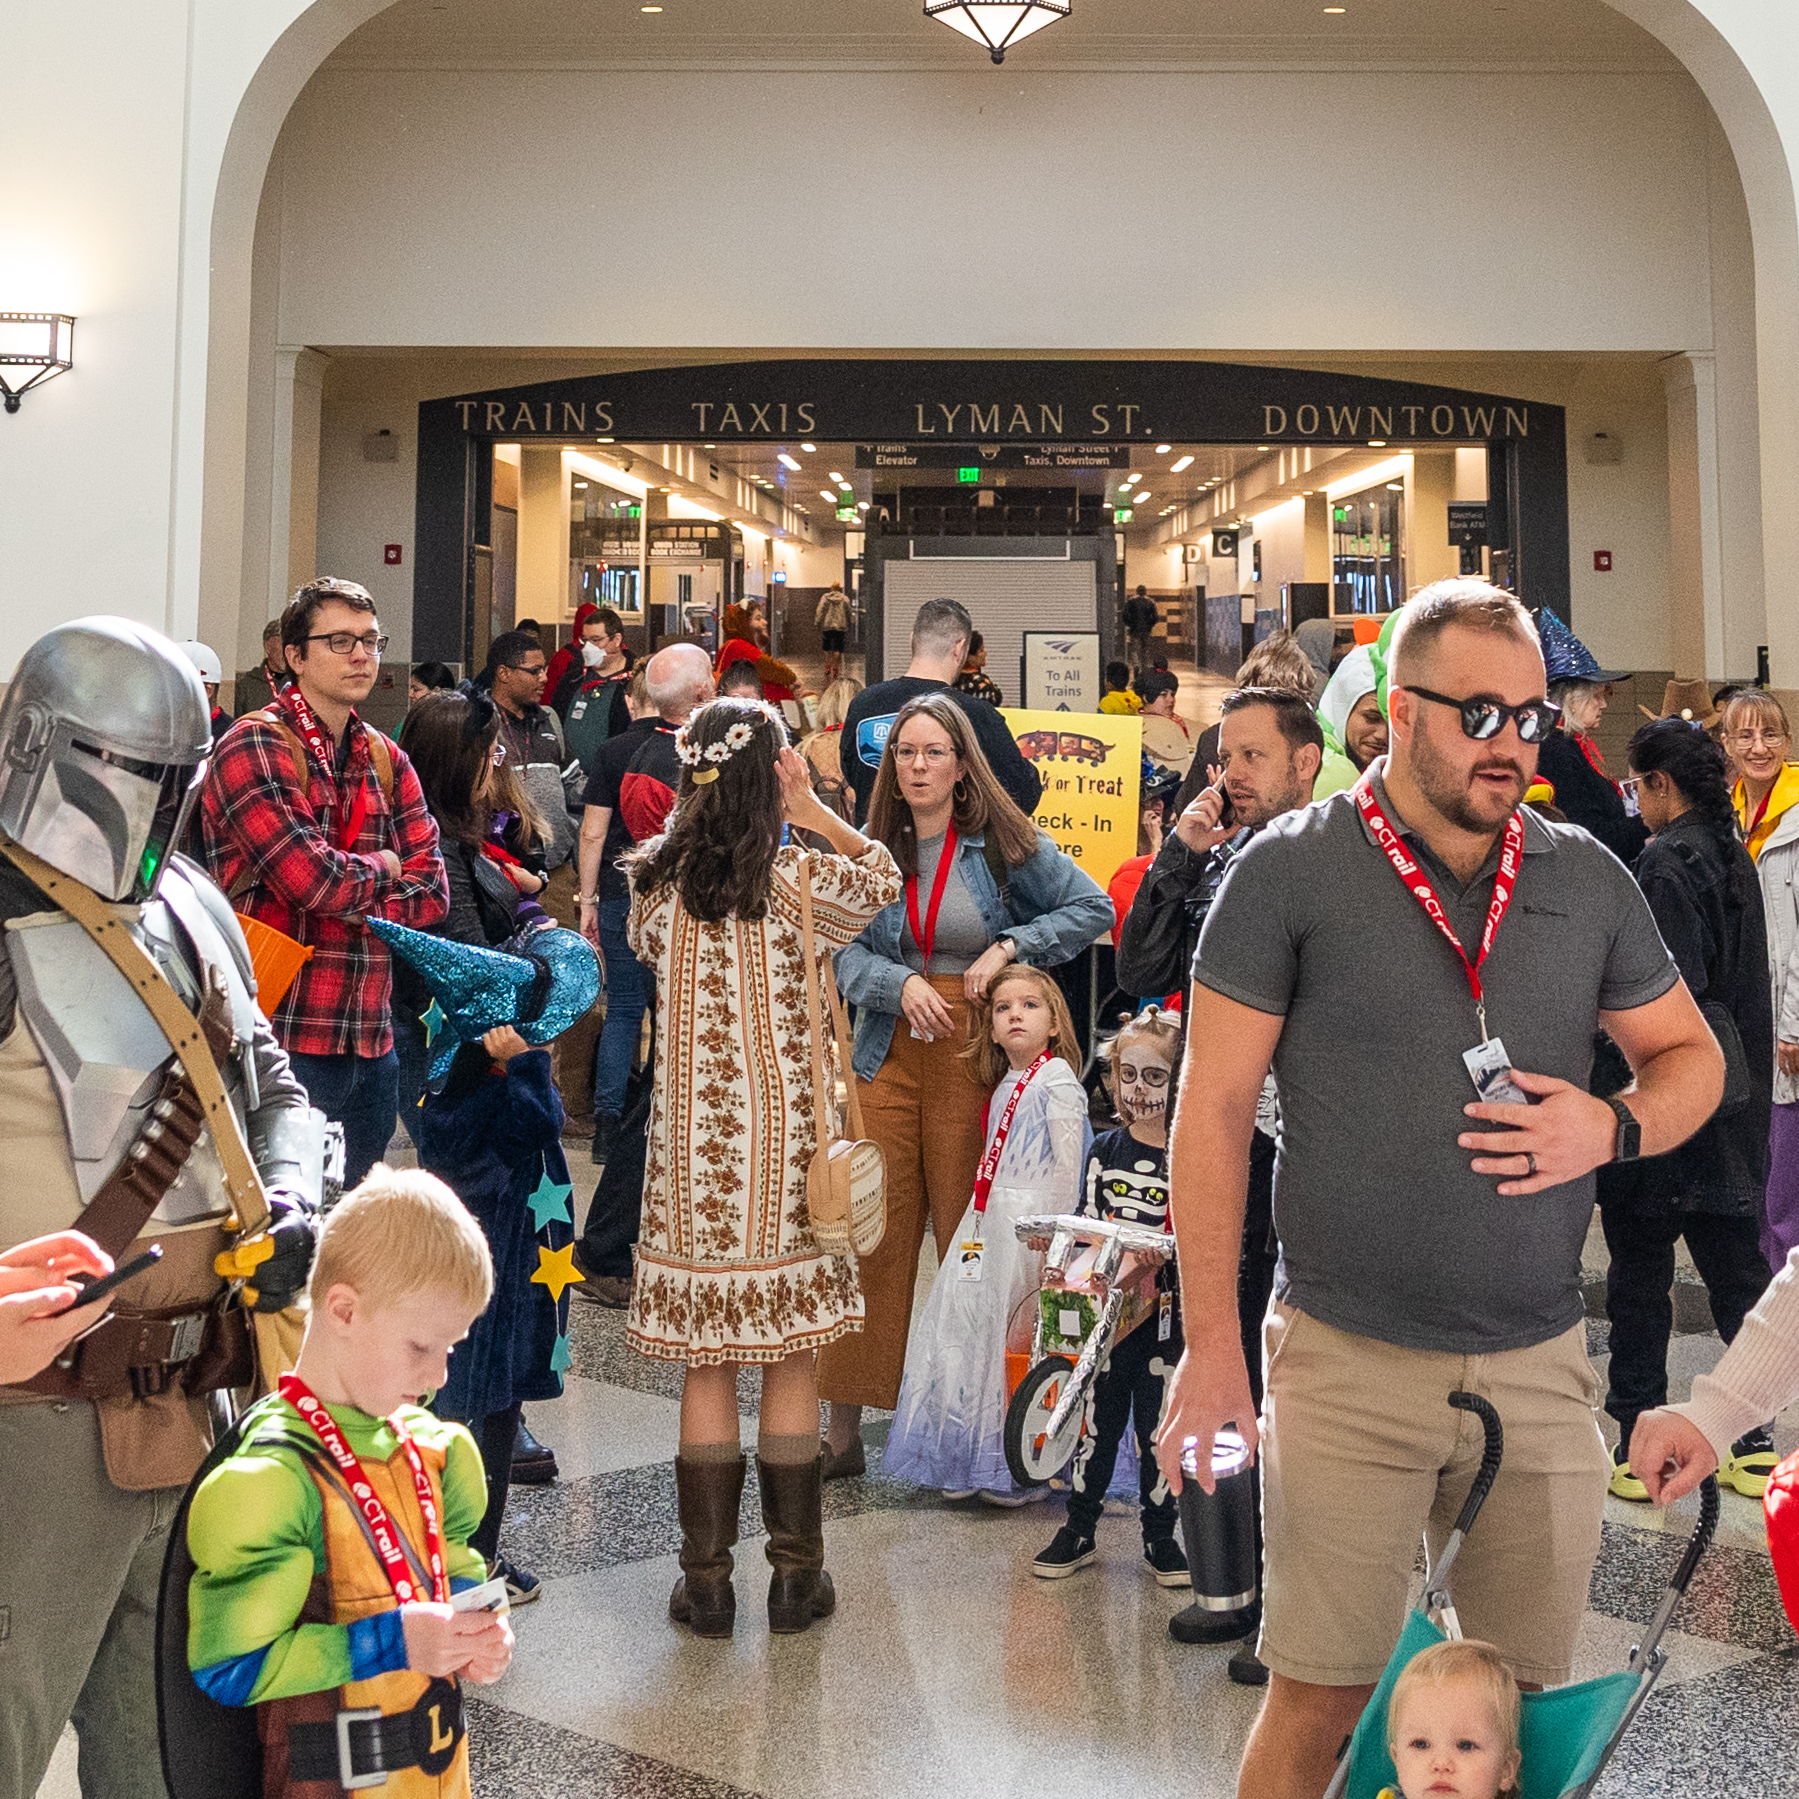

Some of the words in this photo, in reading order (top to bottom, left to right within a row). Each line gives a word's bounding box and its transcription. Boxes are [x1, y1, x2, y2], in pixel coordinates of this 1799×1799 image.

[456, 402, 615, 434] TRAINS
[692, 403, 815, 432] TAXIS
[917, 404, 1062, 433] LYMAN
[1092, 405, 1152, 434] ST.
[1263, 405, 1527, 439] DOWNTOWN
[875, 455, 918, 465] Elevator
[1024, 455, 1053, 466] Taxis,
[1056, 455, 1110, 466] Downtown
[960, 468, 980, 482] EXIT
[1187, 545, 1201, 562] D
[1217, 535, 1233, 555] C
[1046, 670, 1061, 682] To
[1064, 670, 1080, 682] All
[1045, 685, 1082, 698] Trains
[1056, 778, 1070, 791] or
[1076, 775, 1124, 797] Treat
[1031, 813, 1072, 830] eck
[1094, 814, 1112, 832] In
[428, 1703, 454, 1755] L
